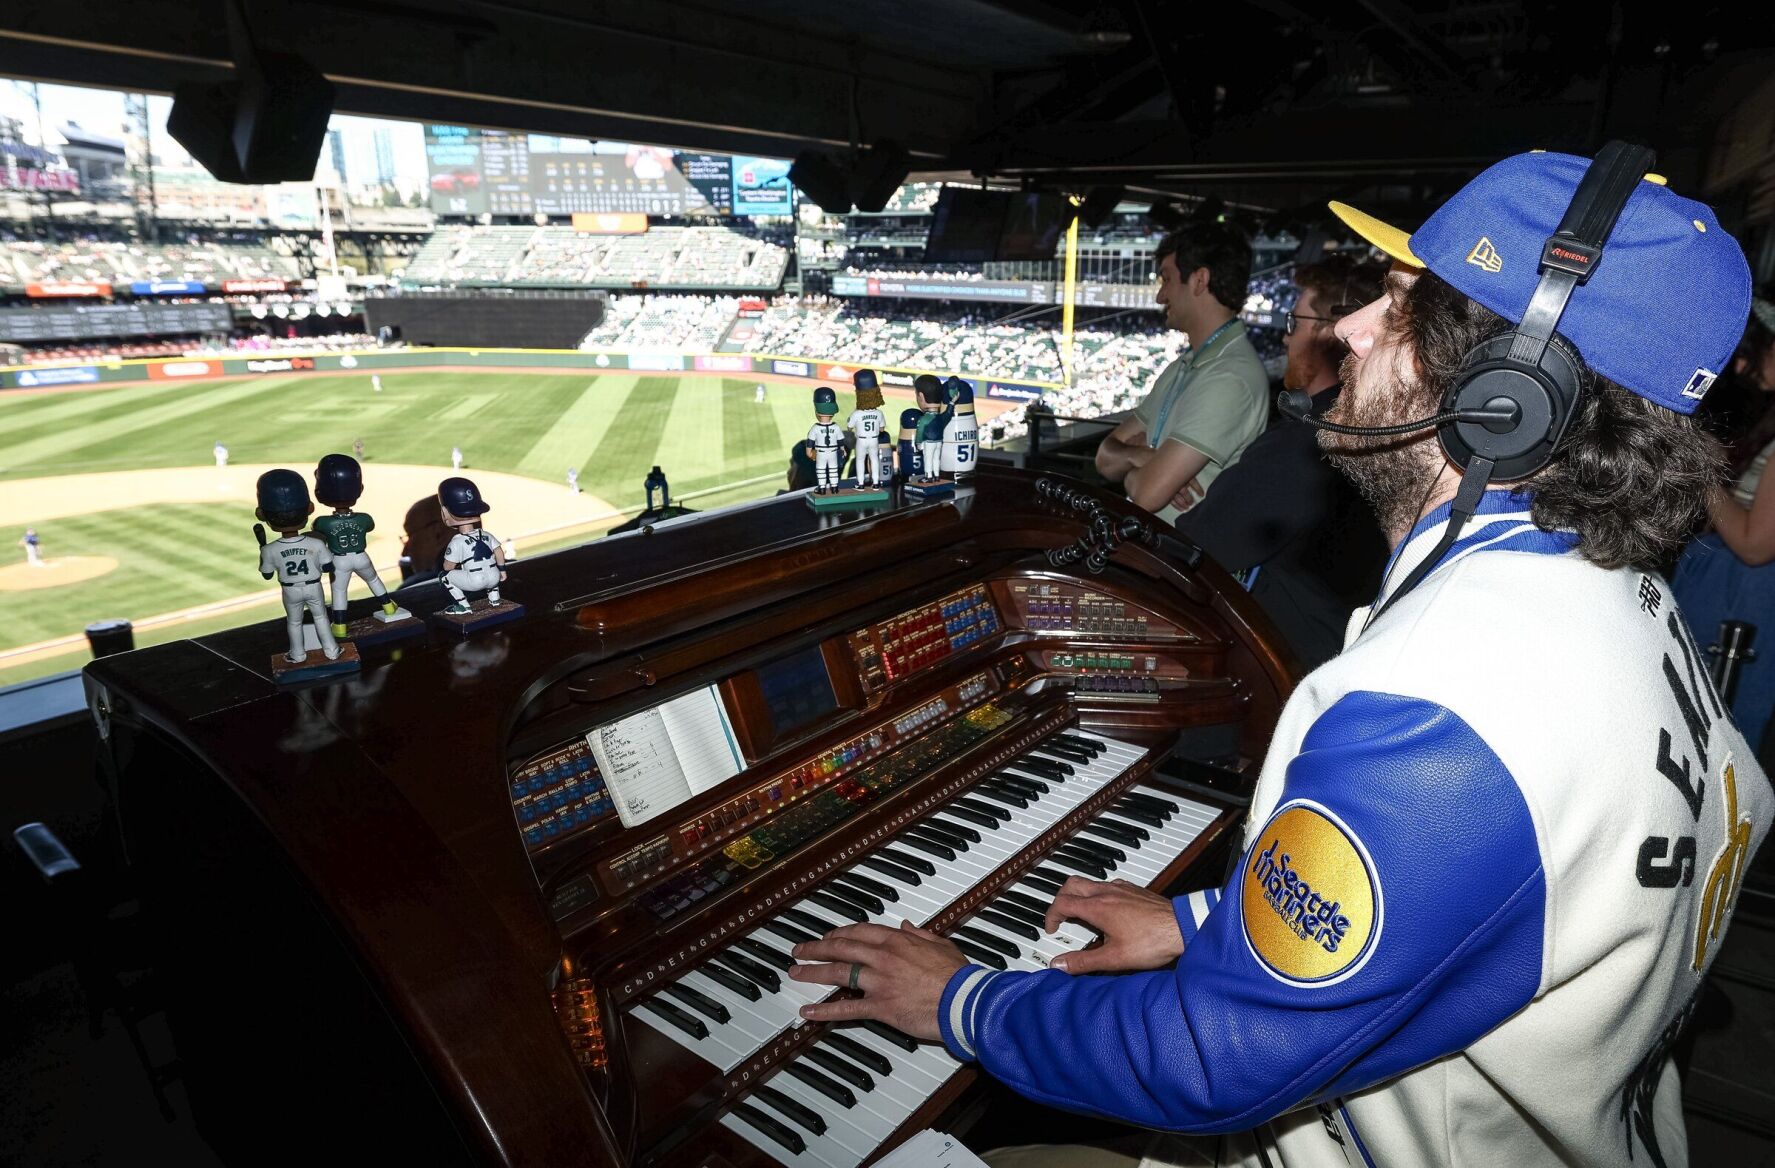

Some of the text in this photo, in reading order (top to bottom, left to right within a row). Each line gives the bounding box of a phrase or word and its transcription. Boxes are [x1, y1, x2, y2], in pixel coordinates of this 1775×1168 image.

[1564, 250, 1589, 264] RIEDEL
[864, 422, 874, 432] 51
[957, 444, 974, 462] 51
[883, 466, 892, 475] 51
[466, 489, 473, 501] S
[285, 559, 309, 576] 24
[631, 844, 645, 852] LOCK
[1274, 853, 1350, 938] Seattle
[1264, 891, 1310, 941] BASEBALL CLUB
[647, 971, 653, 980] D
[669, 958, 676, 966] E
[743, 1072, 748, 1080] D
[764, 1056, 769, 1064] E
